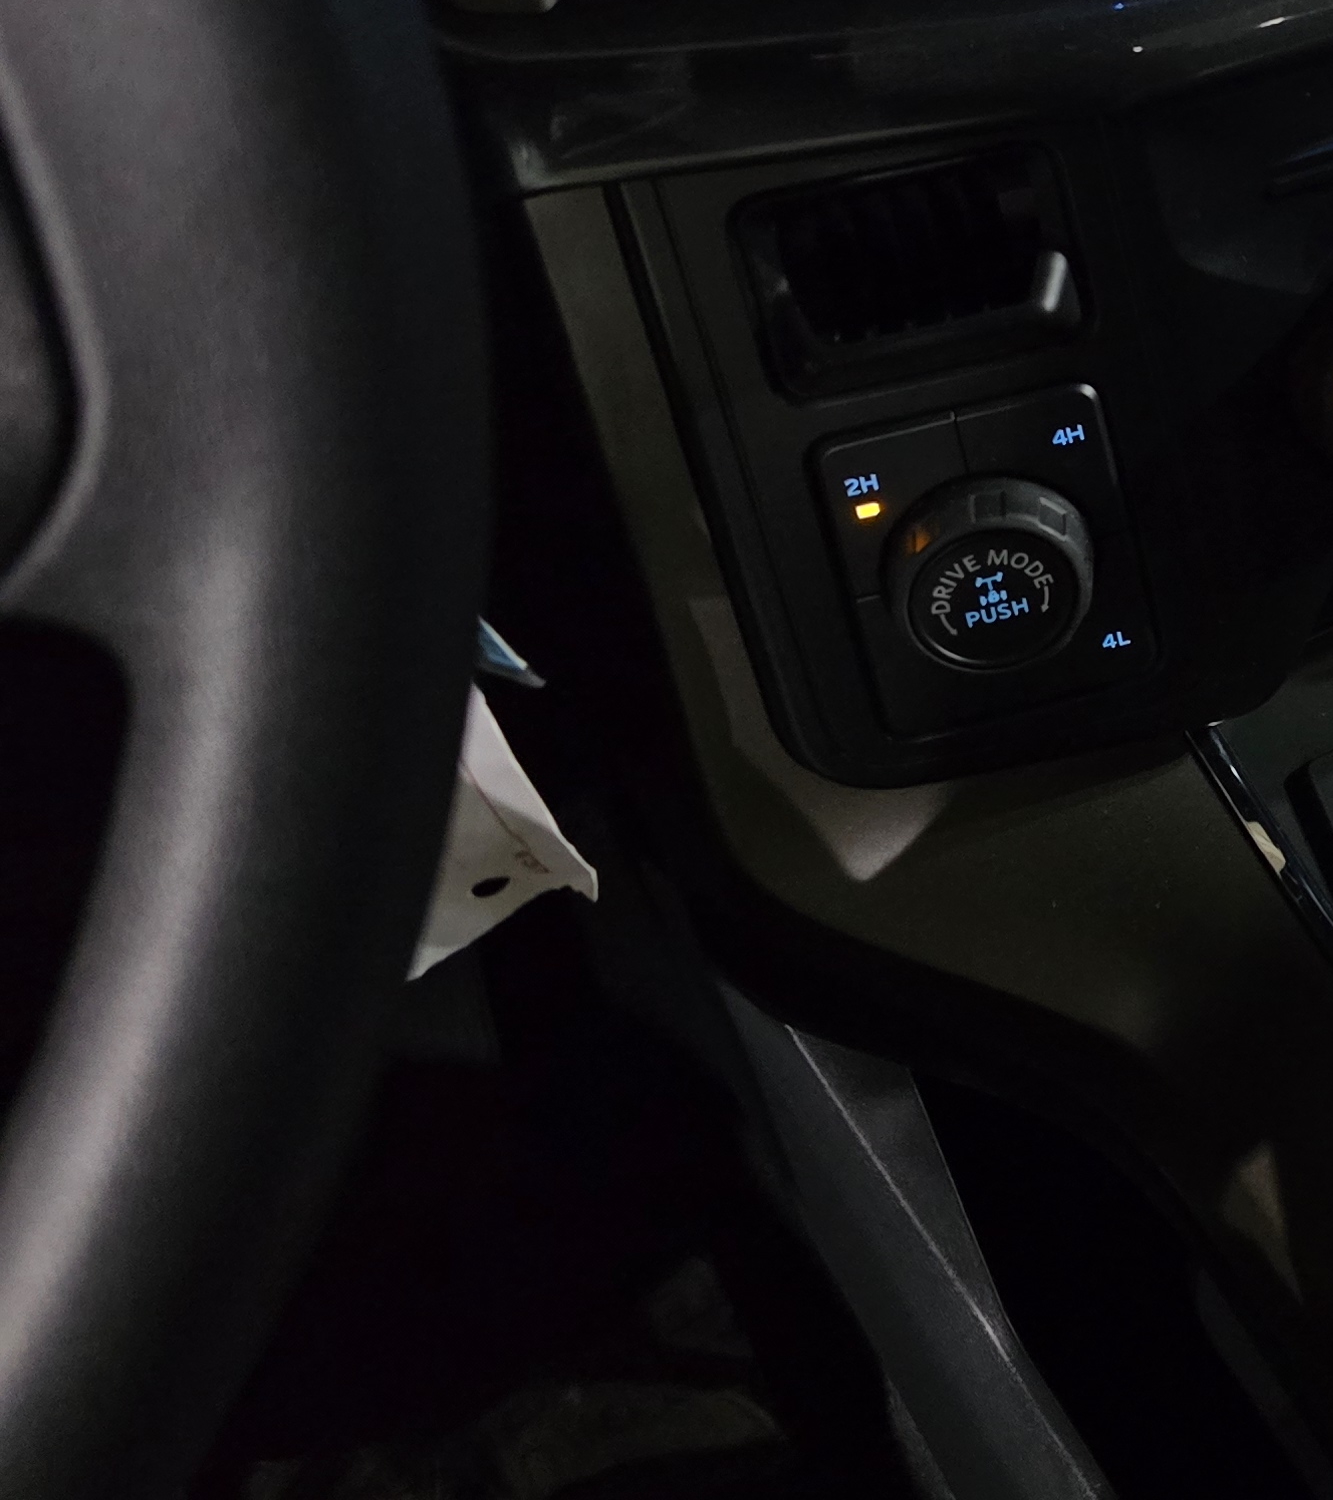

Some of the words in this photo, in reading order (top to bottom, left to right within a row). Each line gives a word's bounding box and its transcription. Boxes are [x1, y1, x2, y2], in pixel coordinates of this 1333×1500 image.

[1052, 424, 1086, 447] 4H
[843, 473, 880, 497] 2H
[931, 553, 981, 616] DRIVE
[986, 549, 1054, 588] MODE
[965, 597, 1030, 629] PUSH
[1102, 631, 1132, 651] 4L
